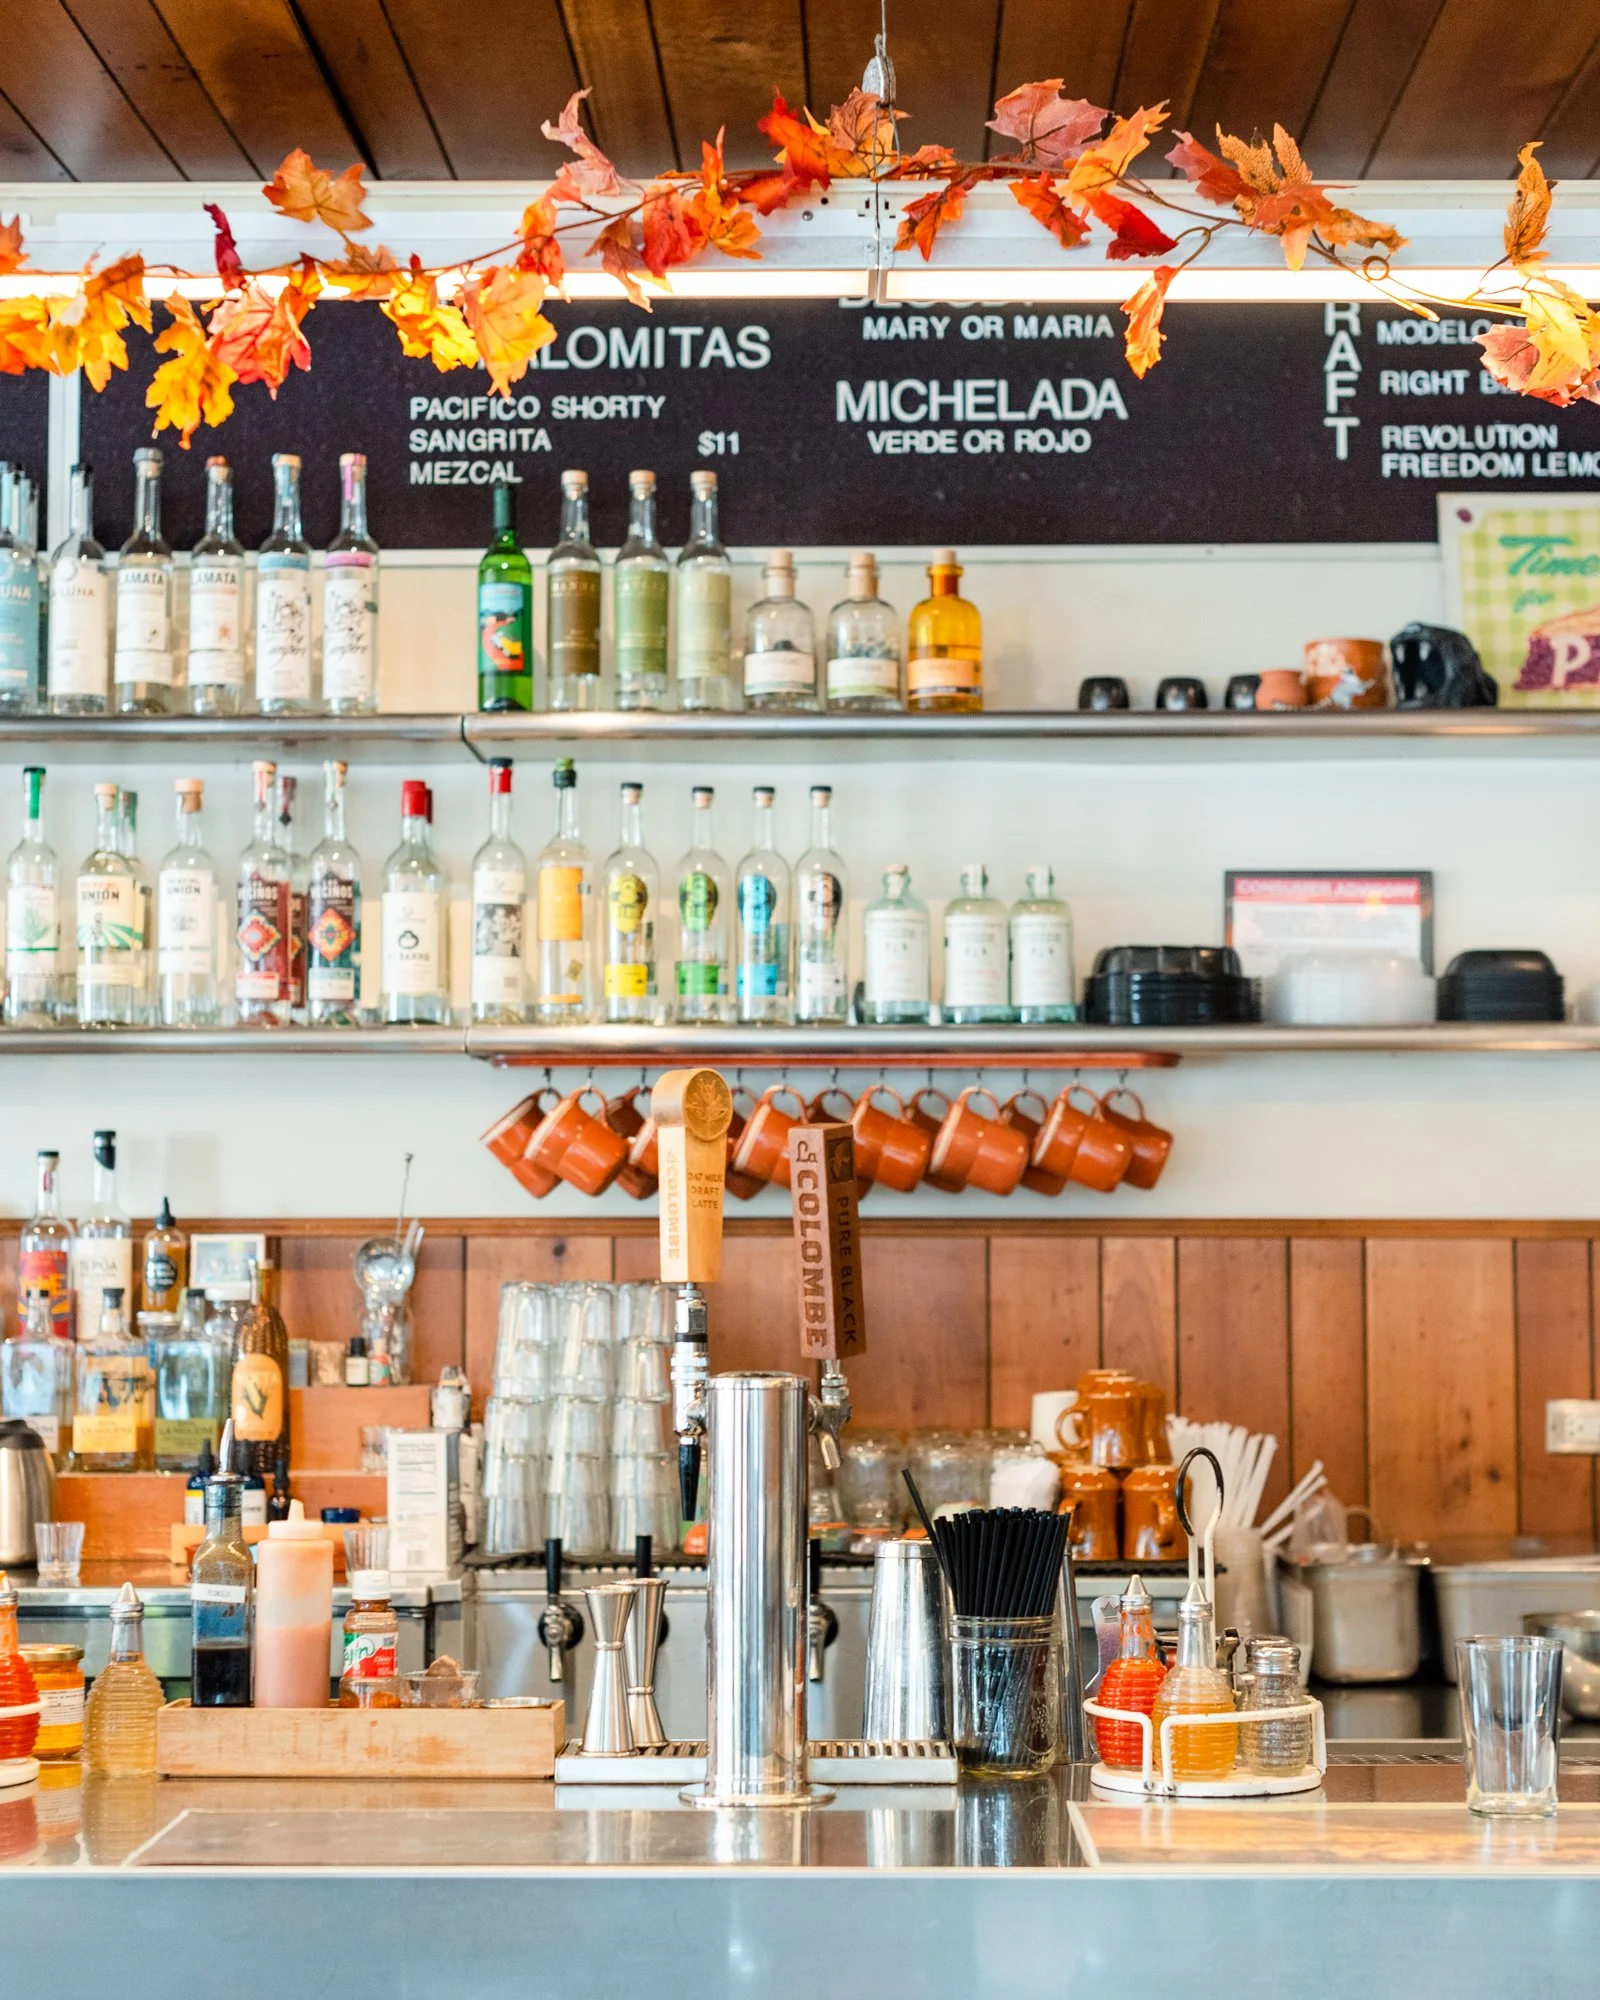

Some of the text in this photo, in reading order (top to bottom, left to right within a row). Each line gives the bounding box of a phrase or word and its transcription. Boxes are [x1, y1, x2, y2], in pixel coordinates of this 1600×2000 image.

[862, 315, 1115, 340] MARY OR MARIA
[1376, 319, 1493, 345] MODELO
[478, 325, 772, 370] LOMITAS
[1379, 370, 1470, 396] RIGHT
[409, 395, 666, 421] PACIFICO SHORTY
[836, 378, 1129, 422] MICHELADA
[409, 428, 552, 453] SANGRITA
[697, 430, 740, 458] $11
[867, 428, 1093, 453] VERDE OR ROJO
[1381, 424, 1558, 450] REVOLUTION
[409, 461, 523, 485] MEZCAL
[1381, 452, 1525, 478] FREEDOM
[691, 1185, 720, 1196] DRAFT
[797, 1169, 828, 1348] COLOMBE
[836, 1195, 858, 1346] PURE BLACK
